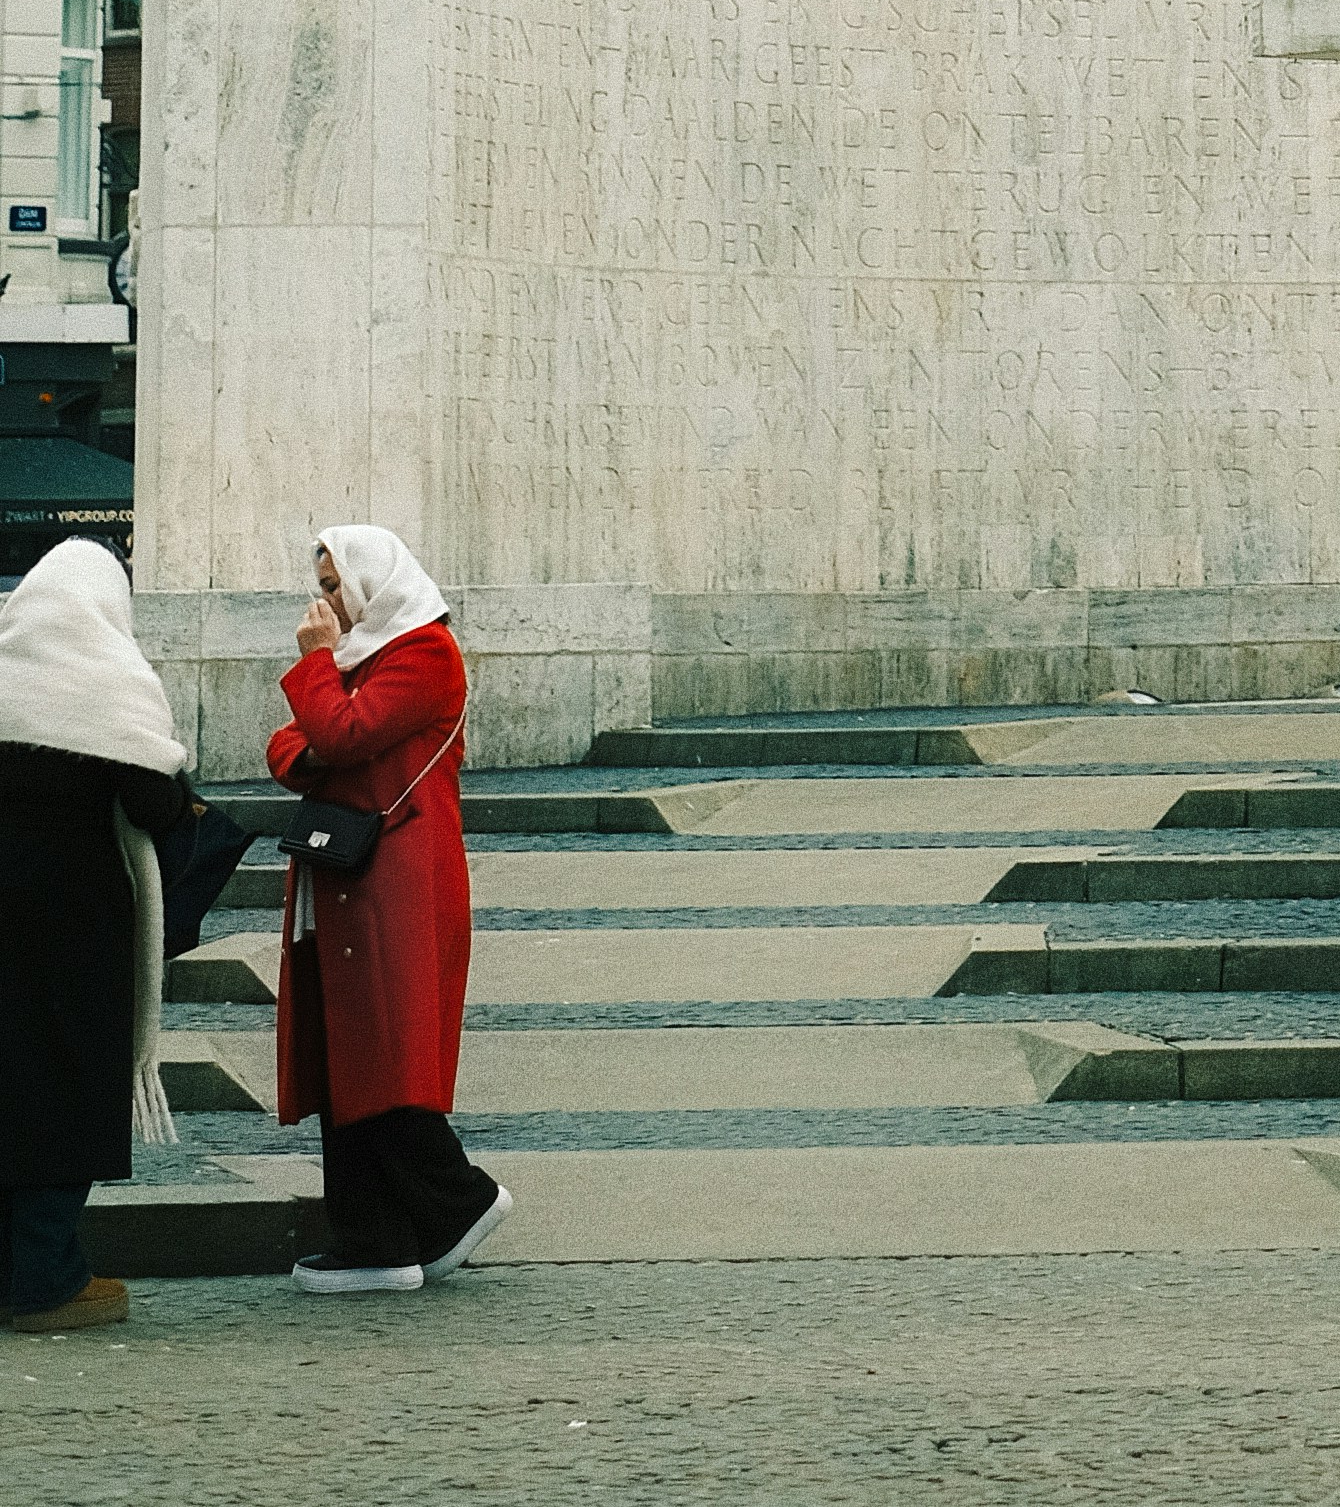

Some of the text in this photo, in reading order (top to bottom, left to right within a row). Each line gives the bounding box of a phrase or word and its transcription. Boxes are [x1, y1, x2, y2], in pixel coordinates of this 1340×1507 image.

[755, 40, 887, 89] GEEST
[911, 45, 1029, 96] BRAK
[1055, 53, 1166, 99] WET
[1192, 58, 1253, 102] EN
[842, 106, 898, 151] DE
[920, 108, 1263, 160] ONTELBAREN
[740, 161, 795, 206] DE
[819, 164, 911, 210] WET
[932, 167, 1109, 215] TERUG
[1143, 172, 1208, 216] EN
